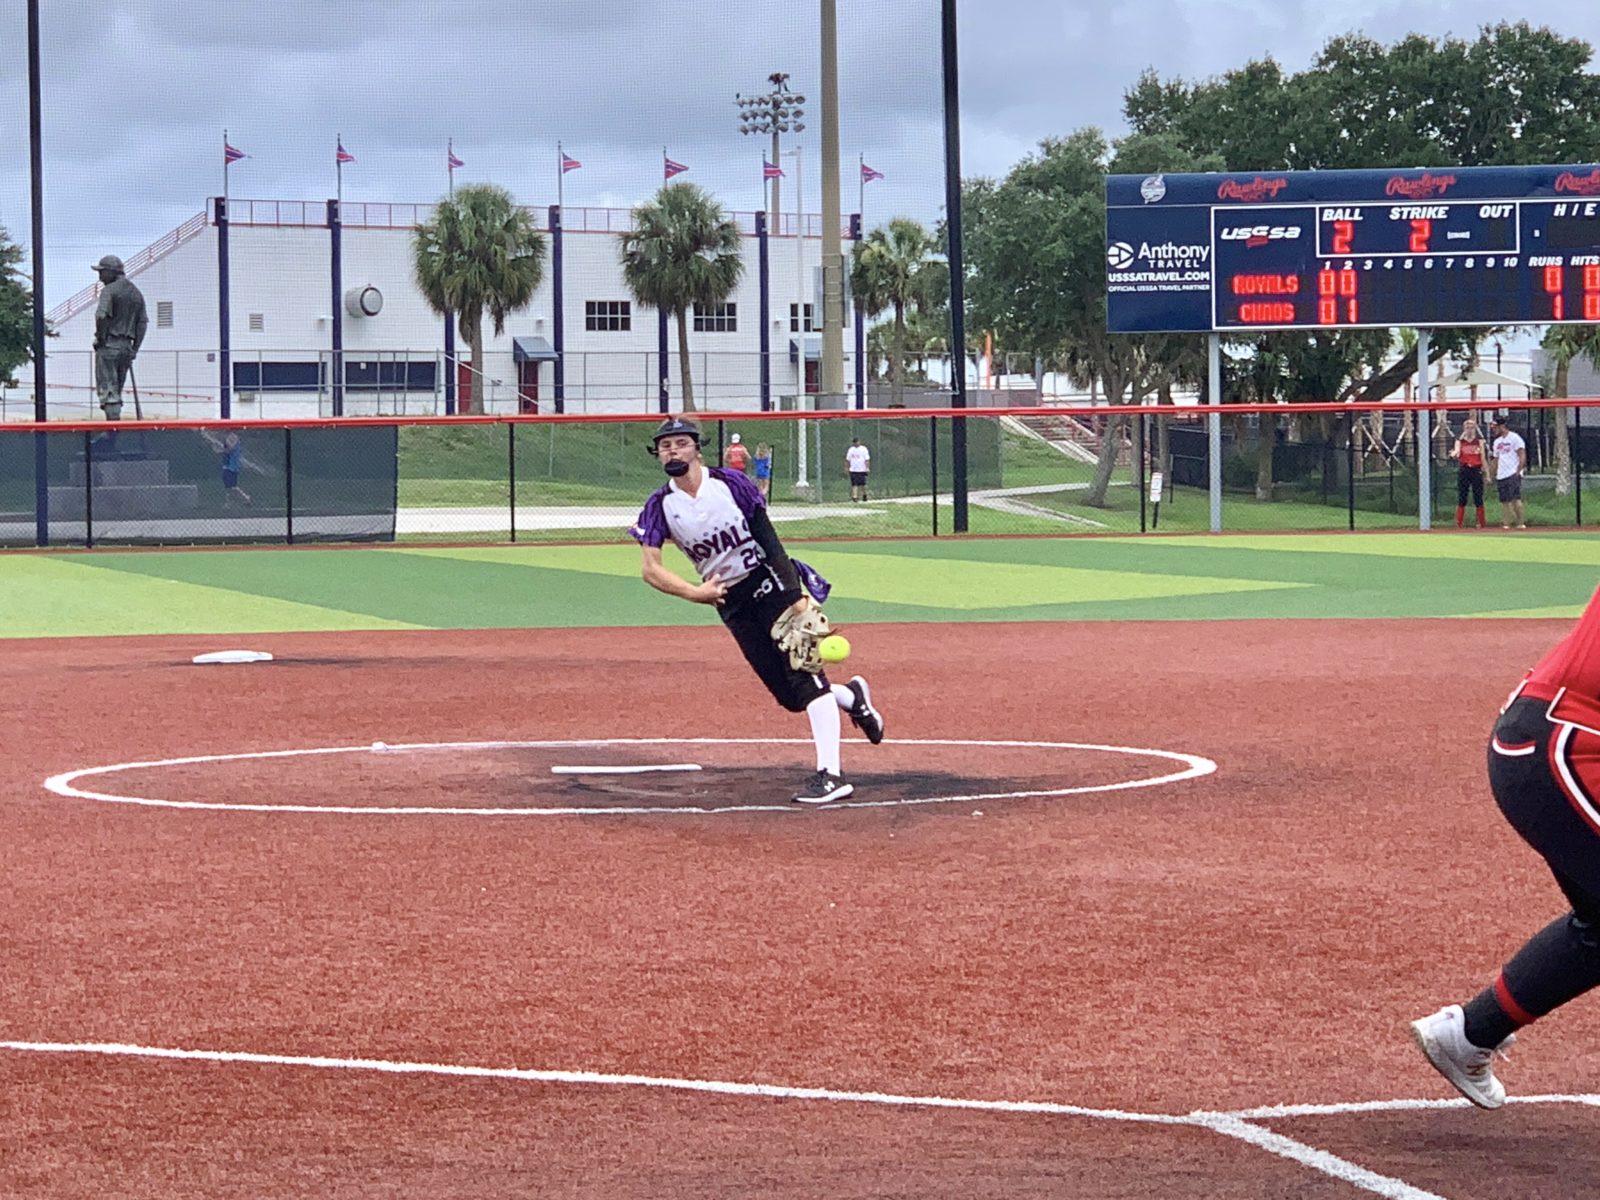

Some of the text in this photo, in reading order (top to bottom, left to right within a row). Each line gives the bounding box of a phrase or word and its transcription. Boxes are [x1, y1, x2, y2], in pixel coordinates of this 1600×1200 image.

[1217, 176, 1289, 202] Rawlings
[1386, 173, 1457, 199] Rawlings
[1322, 204, 1514, 221] BALL STRIKE OUT
[1332, 221, 1355, 254] 2
[1409, 219, 1432, 252] 2
[1138, 242, 1210, 260] Anthony
[1528, 255, 1600, 267] RUNS HITS
[1149, 259, 1200, 269] TRAVEL
[1324, 256, 1518, 270] 1 2 3 4 5 6 7 8 9 10
[1108, 271, 1210, 283] USSSATRAVEL.COM
[1318, 269, 1357, 297] 0 0
[1108, 285, 1137, 293] OFFICIAL
[1158, 284, 1182, 292] TRAVEL
[1318, 298, 1358, 325] 0 1
[1553, 294, 1564, 321] 1
